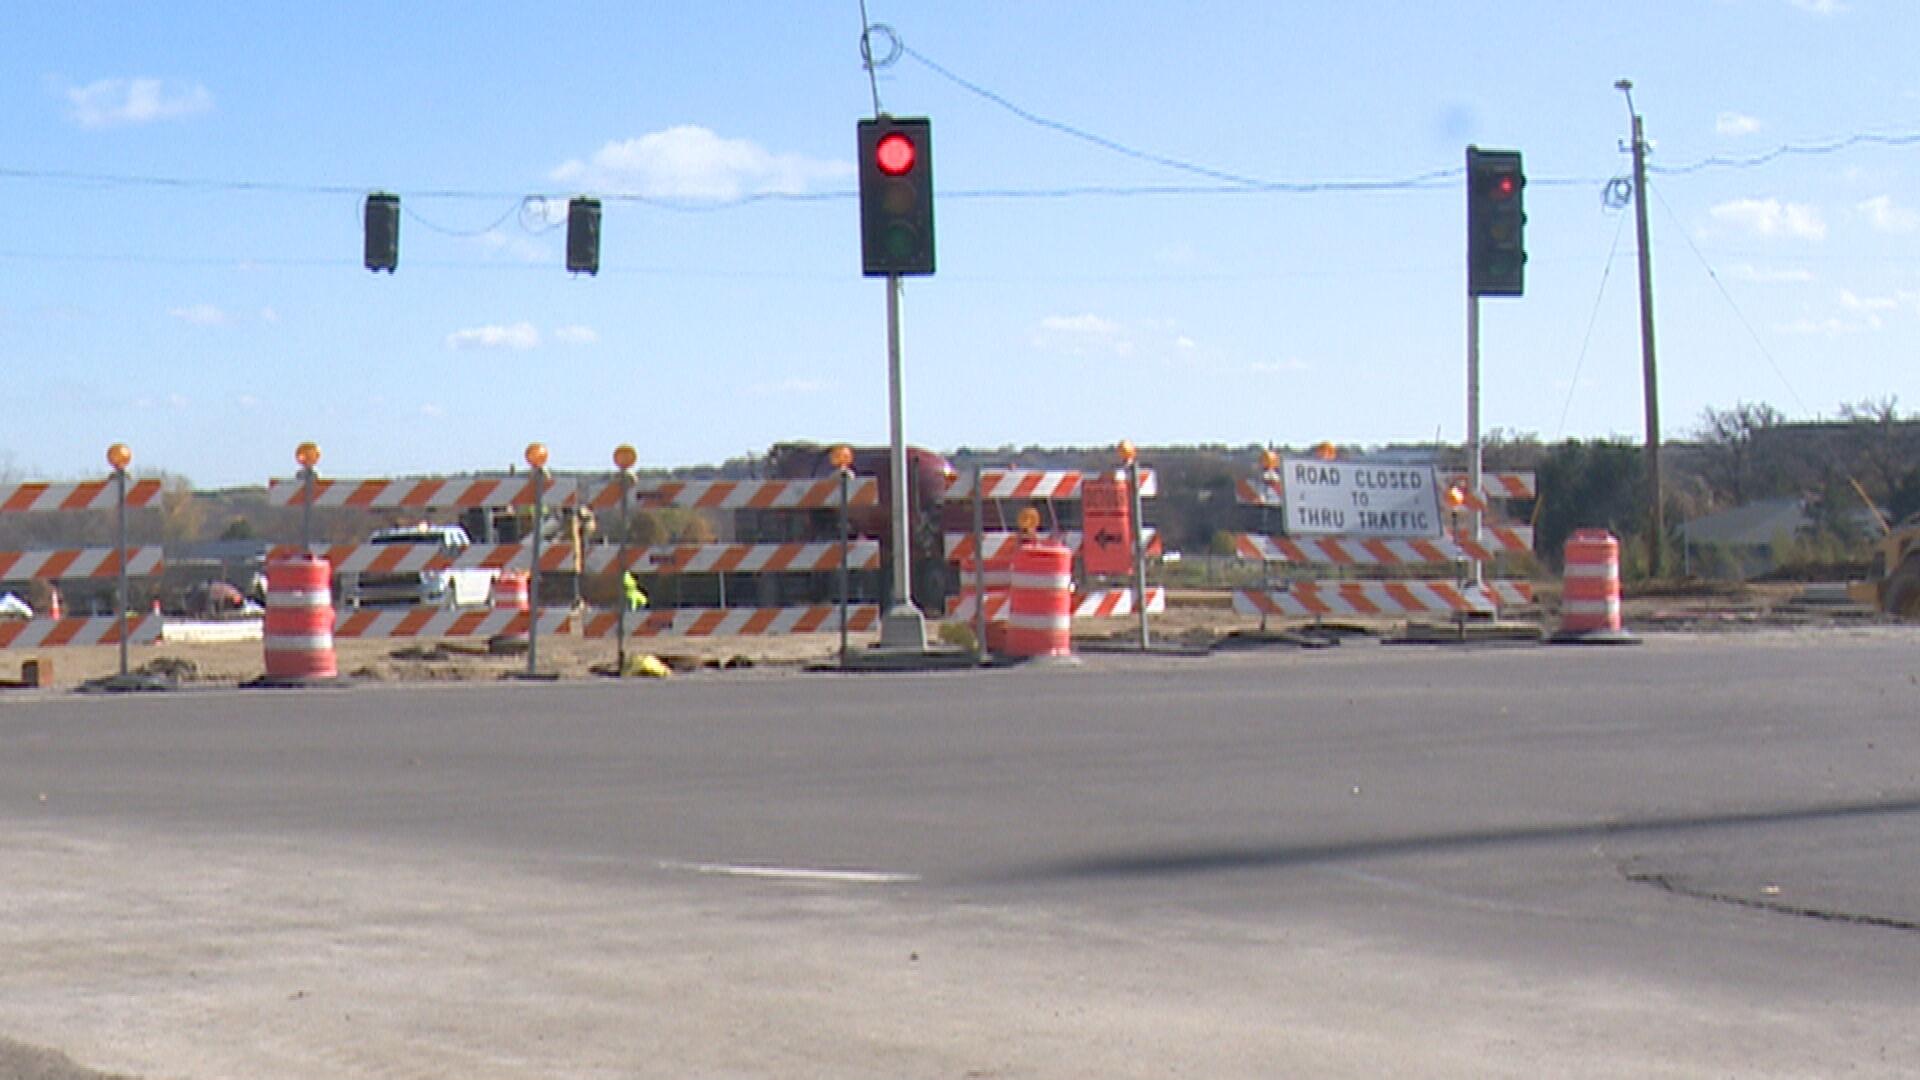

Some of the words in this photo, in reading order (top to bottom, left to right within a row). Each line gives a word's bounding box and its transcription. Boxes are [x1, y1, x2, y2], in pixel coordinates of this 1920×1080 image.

[1295, 464, 1341, 485] ROAD
[1354, 469, 1422, 488] CLOSED
[1351, 491, 1369, 506] TO
[1298, 507, 1345, 527] THRU
[1358, 511, 1428, 529] TRAFFIC
